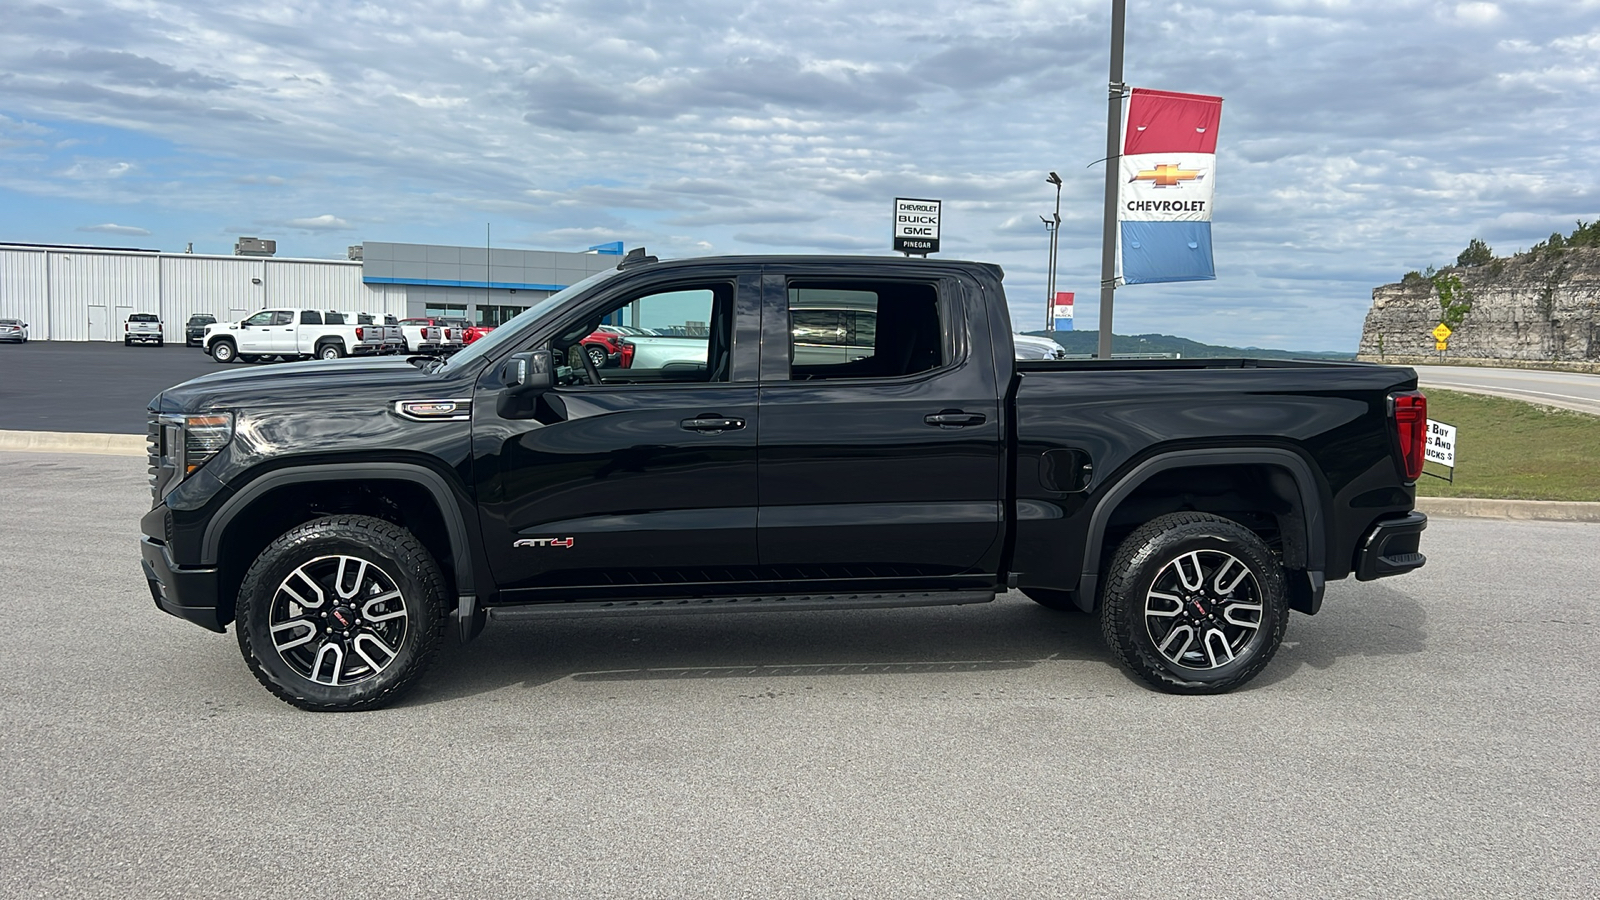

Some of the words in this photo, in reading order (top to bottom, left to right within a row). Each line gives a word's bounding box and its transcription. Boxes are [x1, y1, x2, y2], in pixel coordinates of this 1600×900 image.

[899, 204, 937, 212] CHEVROLET
[1127, 201, 1205, 211] CHEVROLET
[899, 215, 937, 224] BUICK
[904, 227, 932, 235] GMC
[903, 241, 931, 249] PINEGAR
[1426, 448, 1445, 461] UCKS
[513, 537, 574, 548] AT4
